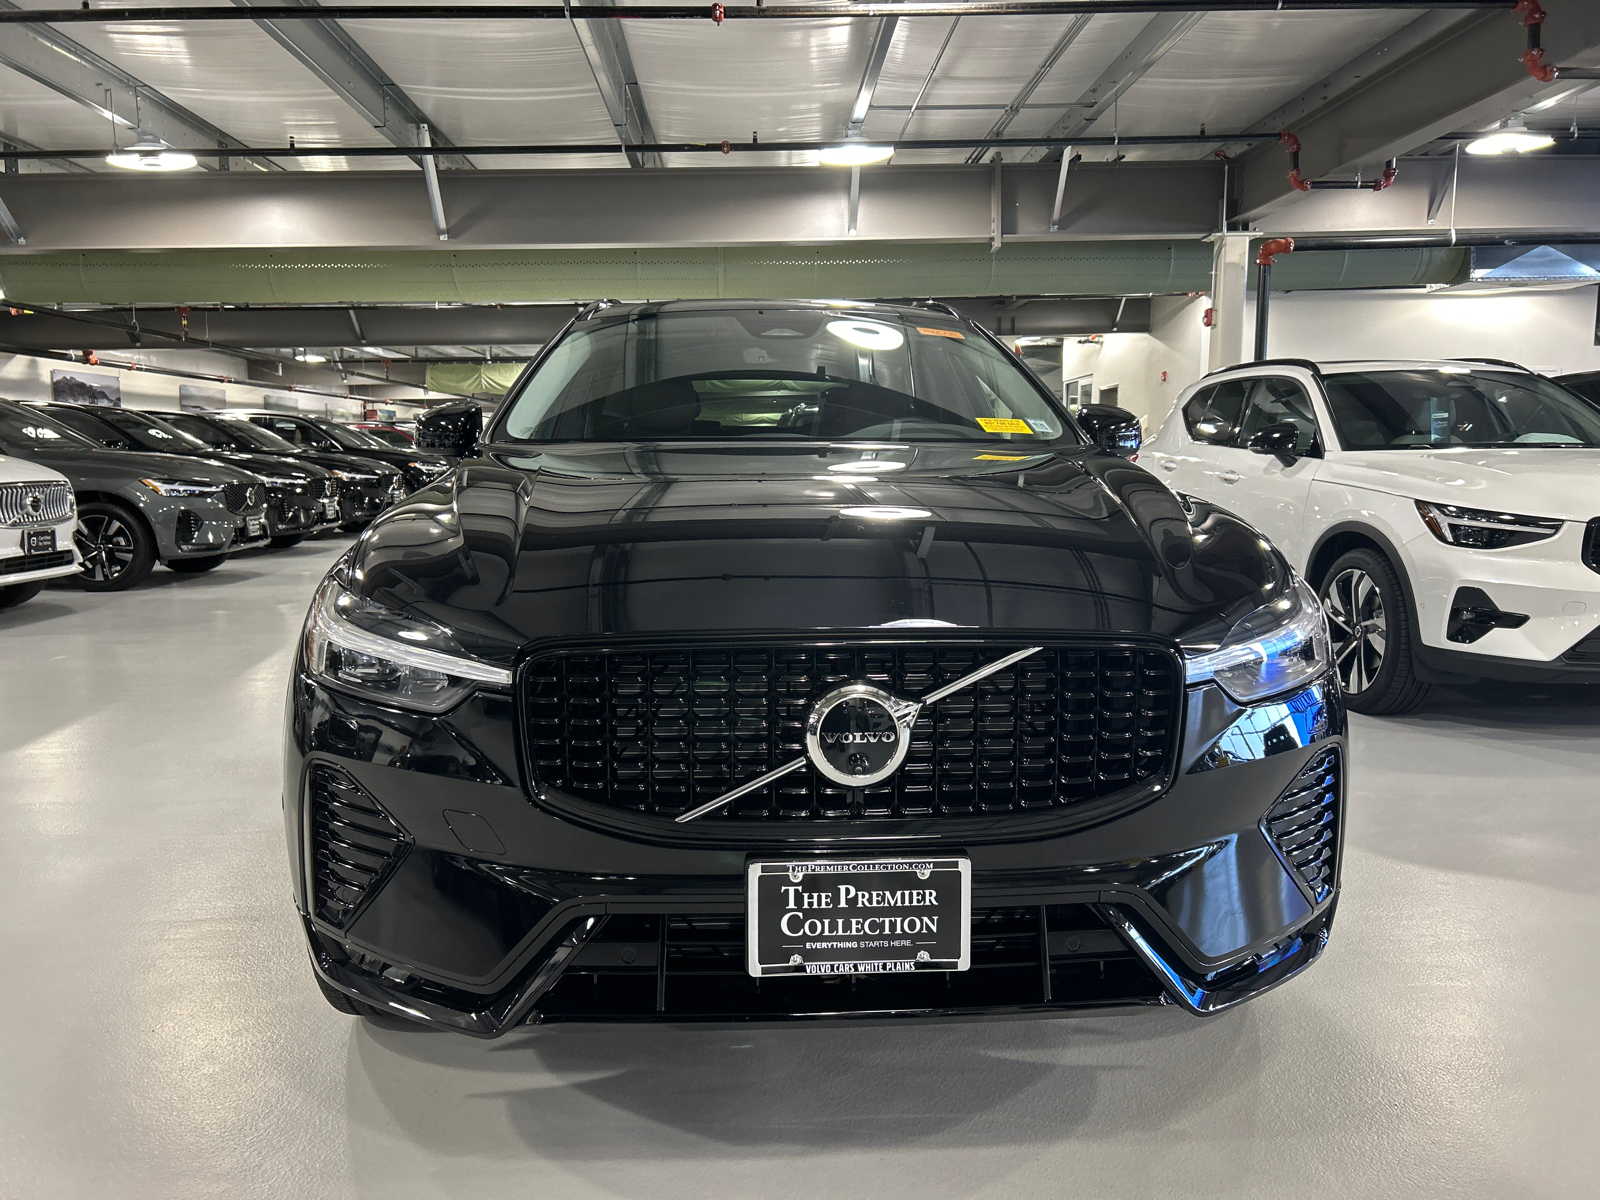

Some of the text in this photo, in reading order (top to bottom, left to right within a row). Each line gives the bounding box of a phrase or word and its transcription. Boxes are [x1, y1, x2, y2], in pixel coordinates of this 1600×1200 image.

[821, 731, 896, 744] VOLVO
[780, 884, 939, 909] THE PREMIER
[780, 911, 939, 937] COLLECTION
[805, 939, 914, 949] EVERYTHING STARTS HERE.
[805, 961, 916, 974] VOLVO CARS WHITE PLAINS
